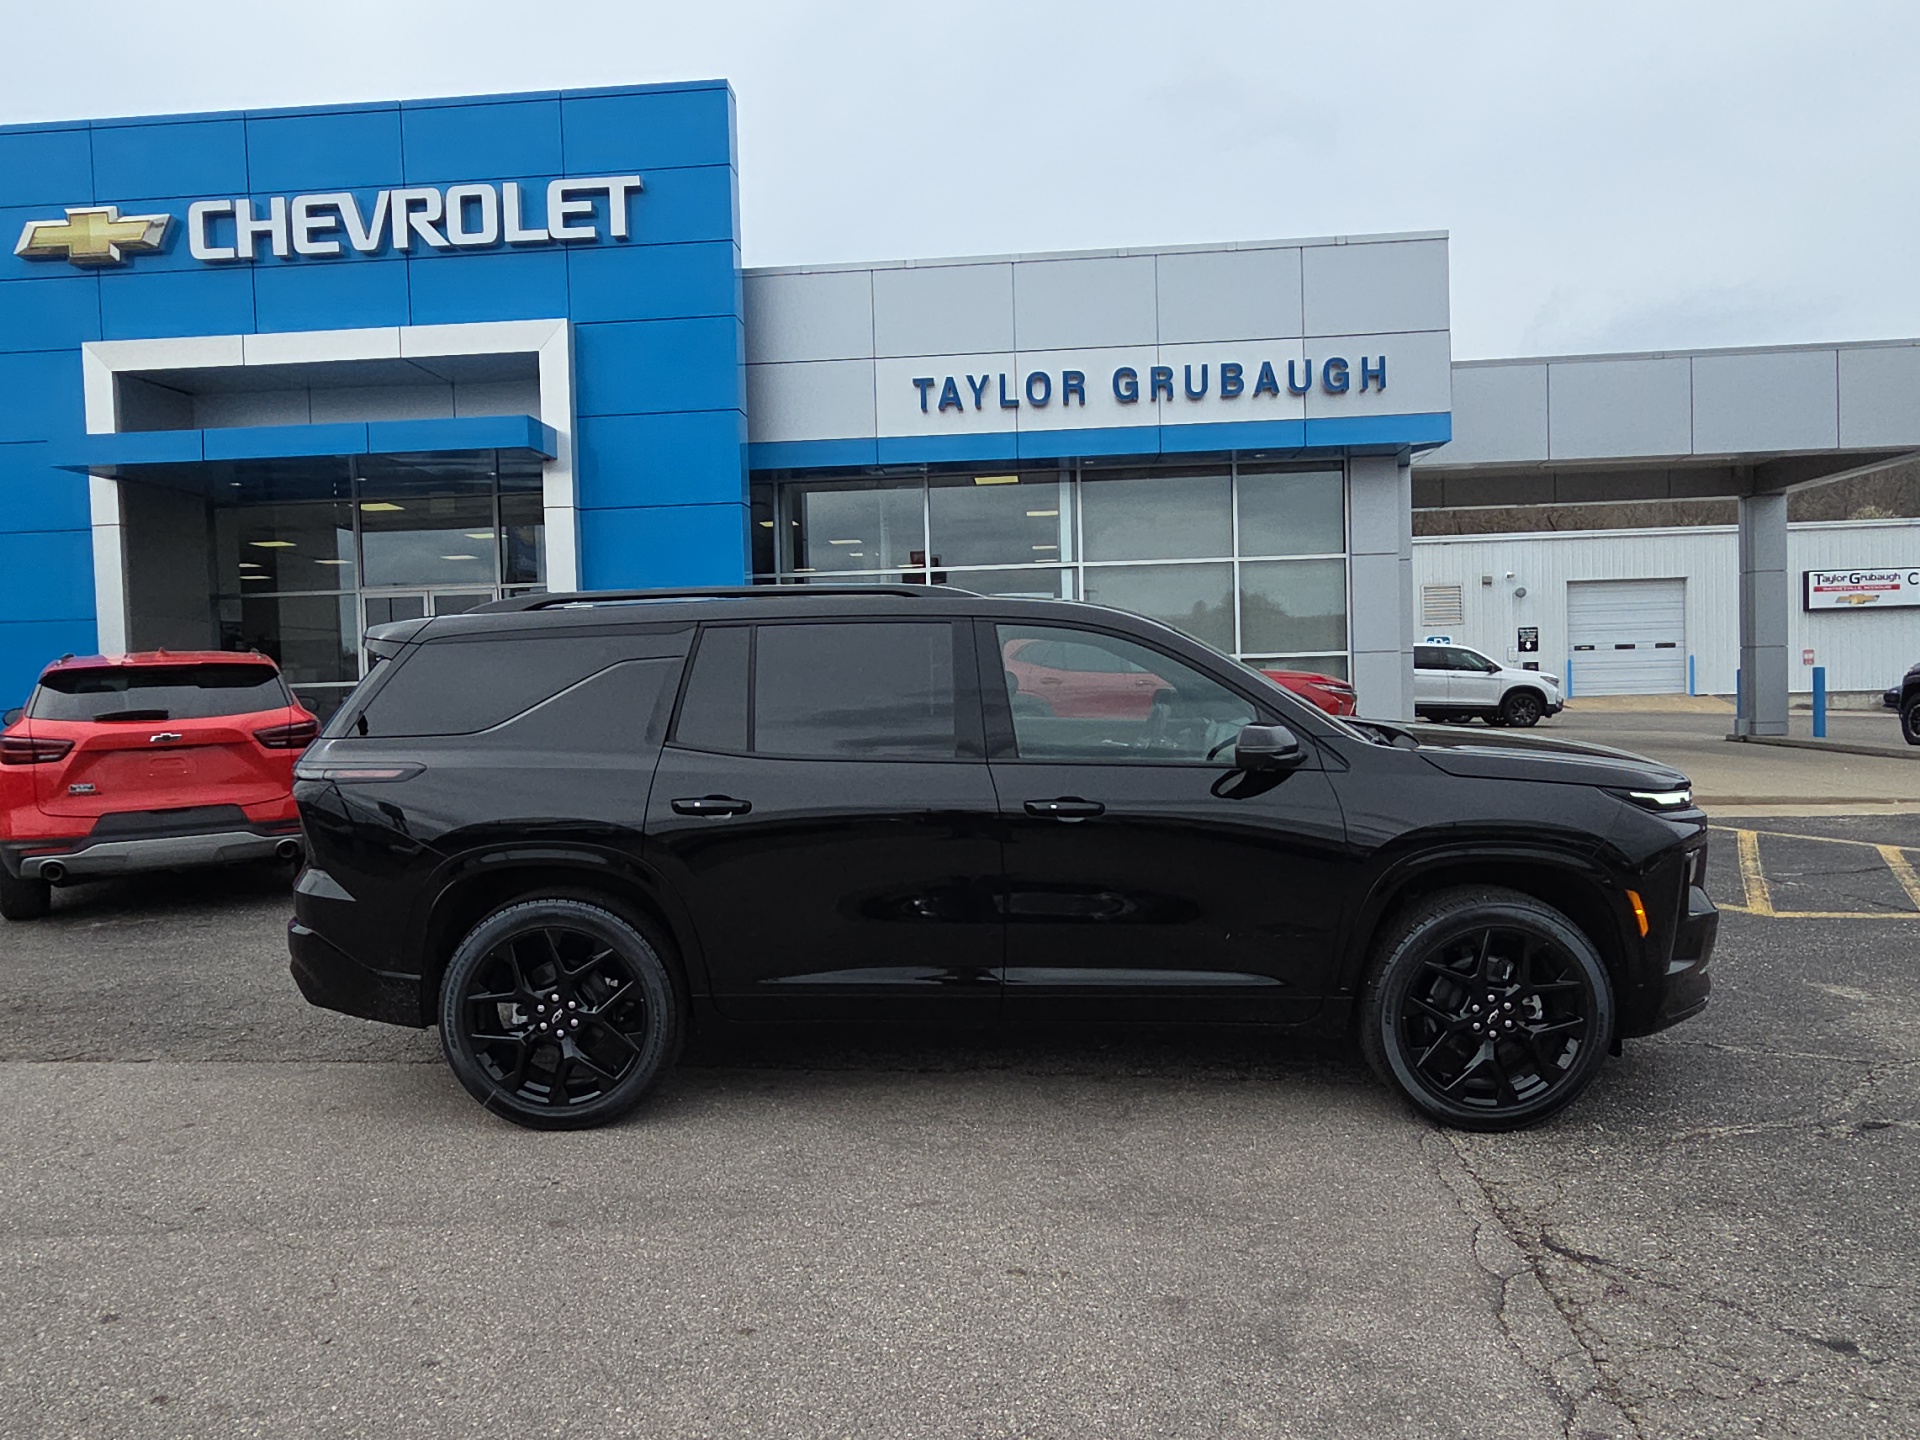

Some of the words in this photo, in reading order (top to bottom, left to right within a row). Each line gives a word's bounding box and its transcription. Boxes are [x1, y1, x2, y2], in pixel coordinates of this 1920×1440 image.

[188, 175, 642, 261] CHEVROLET
[912, 369, 1087, 413] TAYLOR
[1111, 355, 1388, 403] GRUBAUGH
[1813, 574, 1847, 585] Taylor
[1849, 573, 1901, 585] Grubaugh
